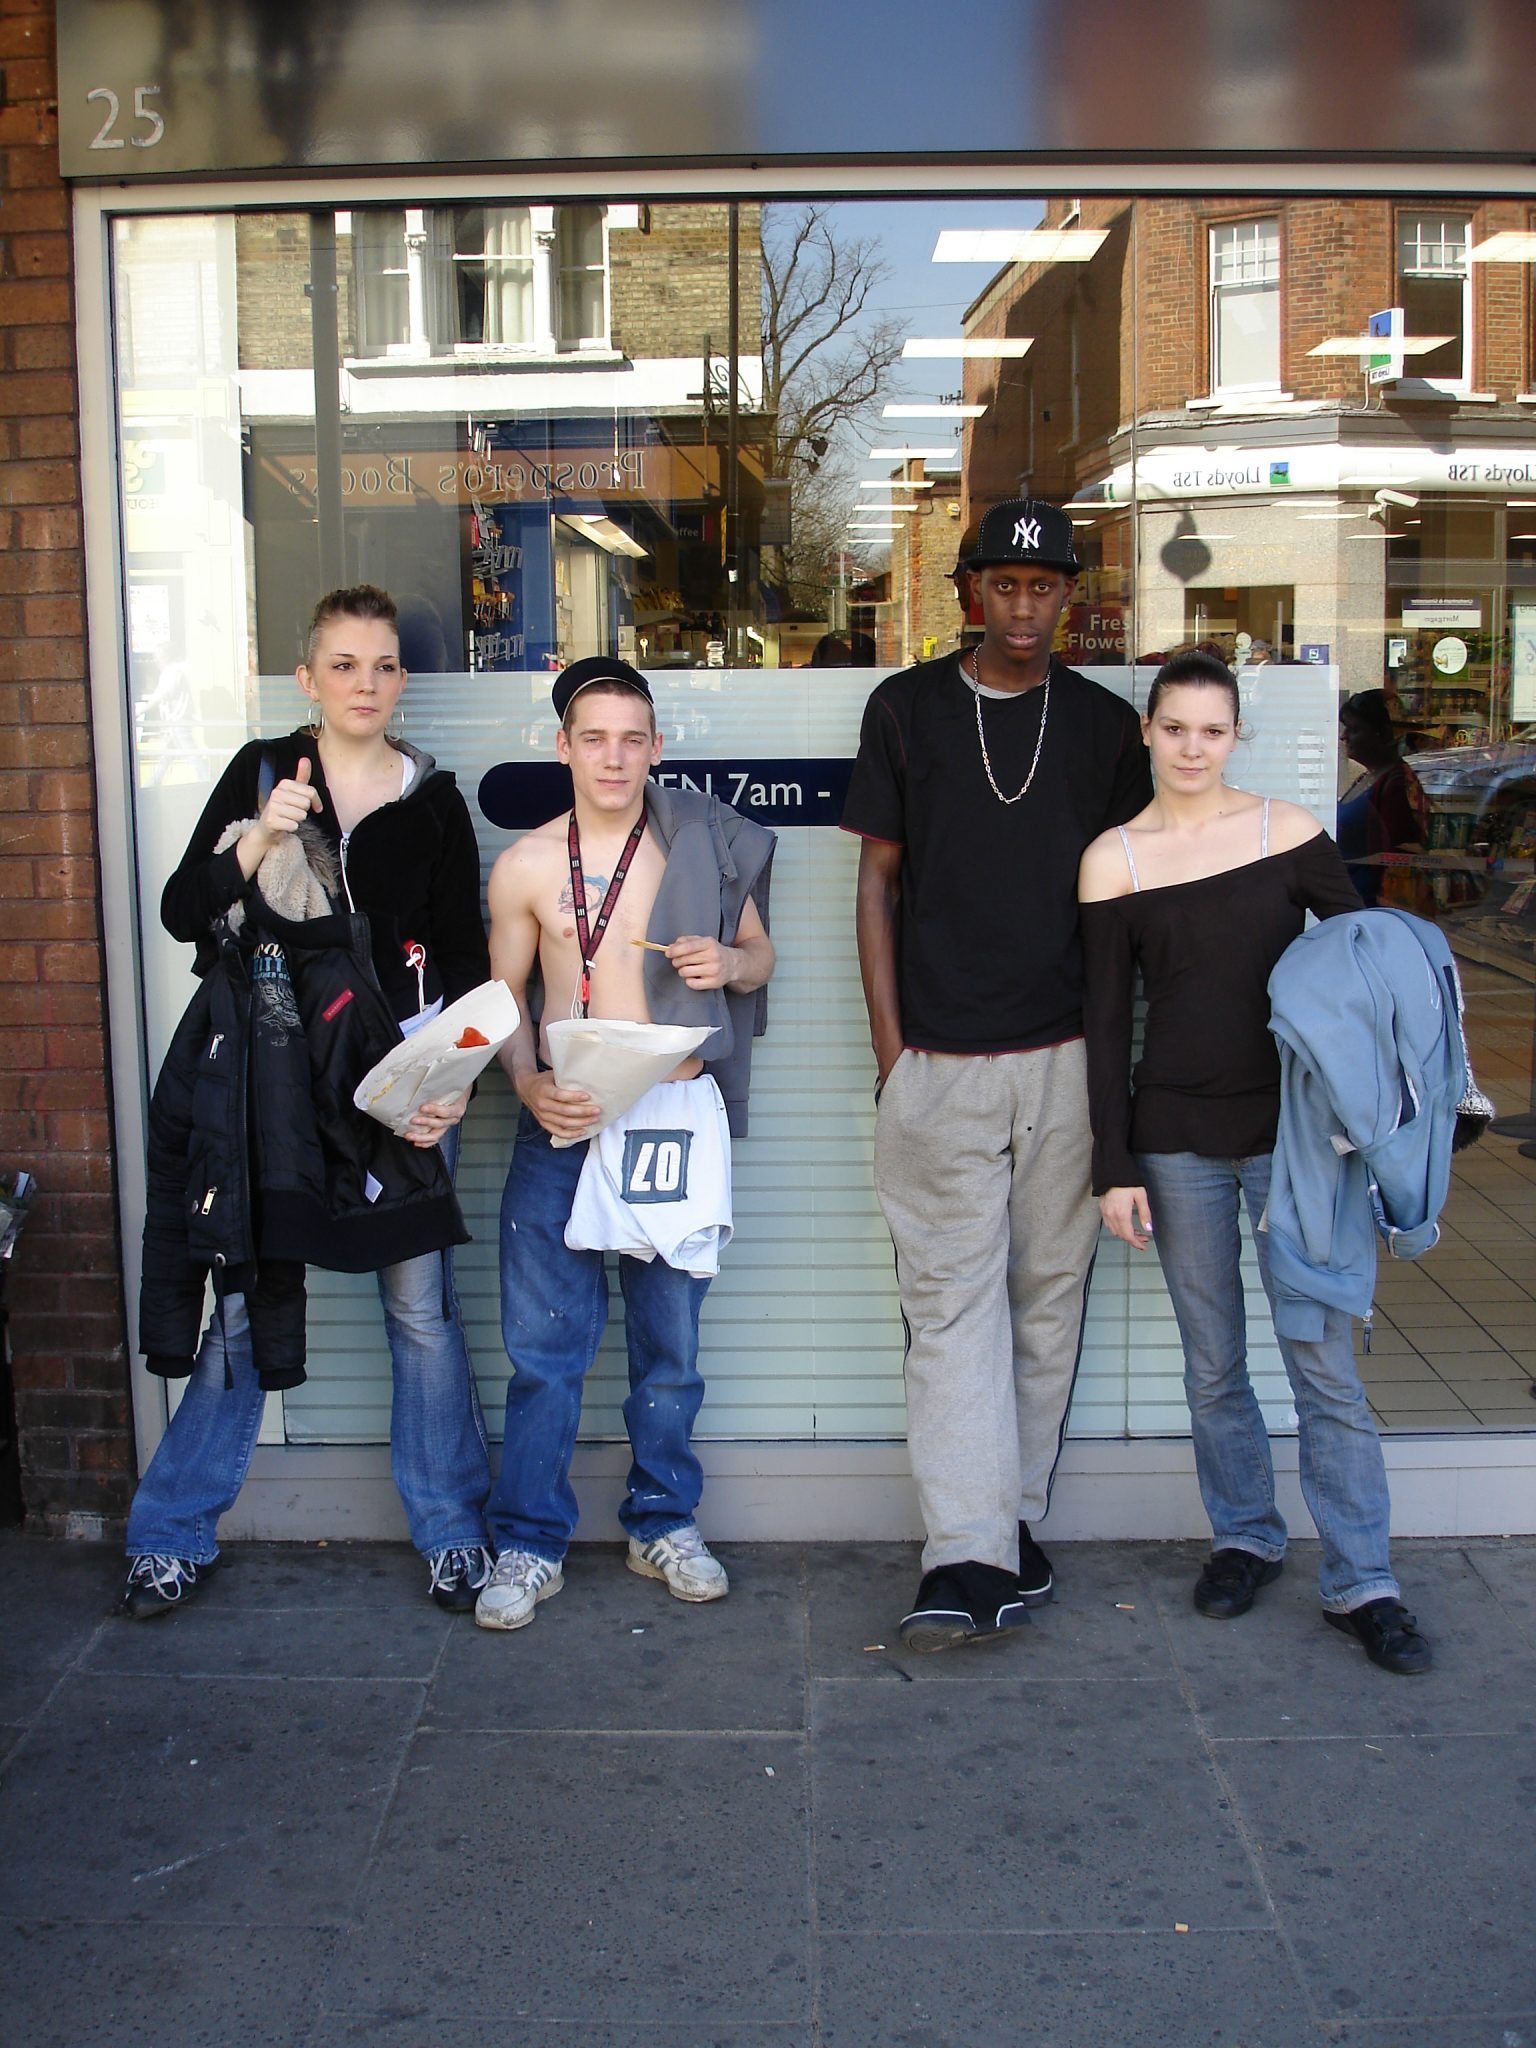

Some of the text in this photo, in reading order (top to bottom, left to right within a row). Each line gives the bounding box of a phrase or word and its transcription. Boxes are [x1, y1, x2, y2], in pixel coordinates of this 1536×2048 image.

[86, 86, 165, 150] 25
[1011, 517, 1042, 549] NY
[727, 772, 803, 807] 7am
